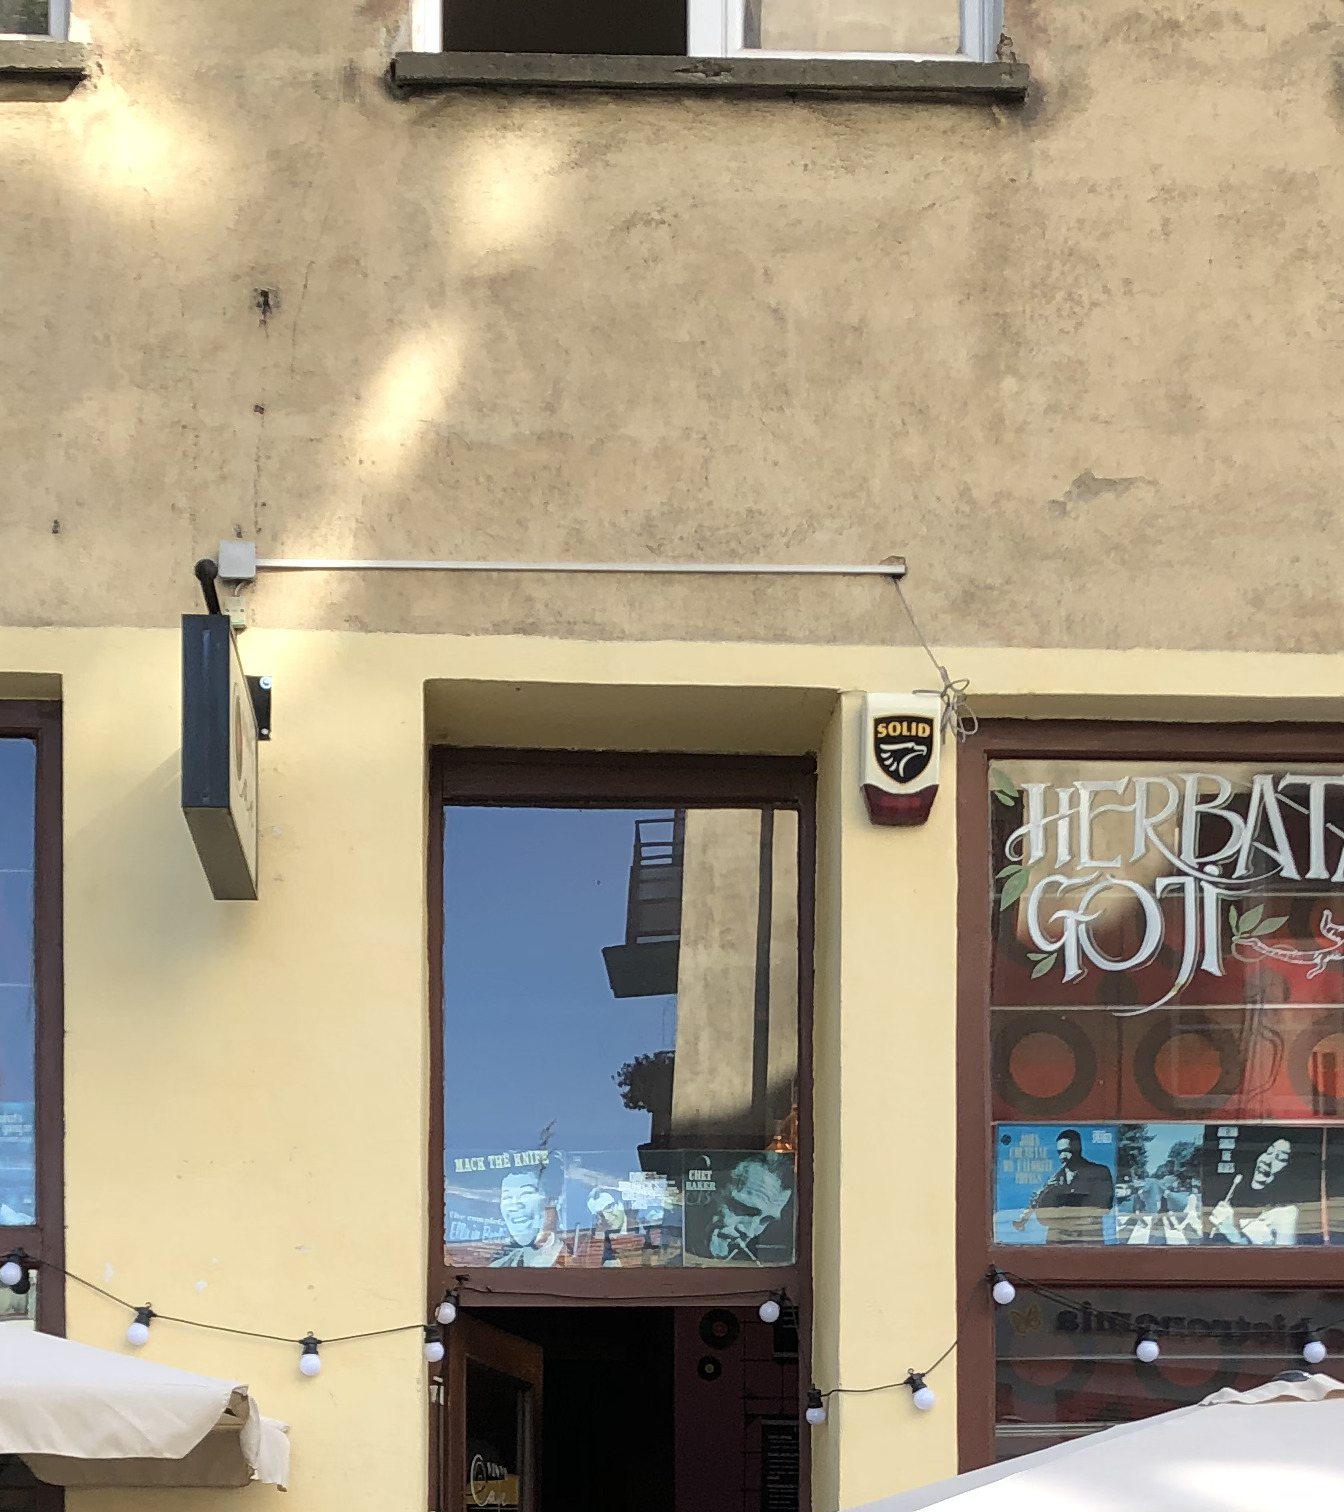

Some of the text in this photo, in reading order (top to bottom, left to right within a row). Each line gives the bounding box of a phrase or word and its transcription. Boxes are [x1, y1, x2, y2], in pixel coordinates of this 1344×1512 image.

[876, 721, 931, 738] SOLID
[1026, 863, 1254, 1016] GOJI
[454, 1150, 550, 1173] MACK THE KNIFE
[688, 1169, 713, 1181] CHET
[685, 1181, 716, 1191] BAKER
